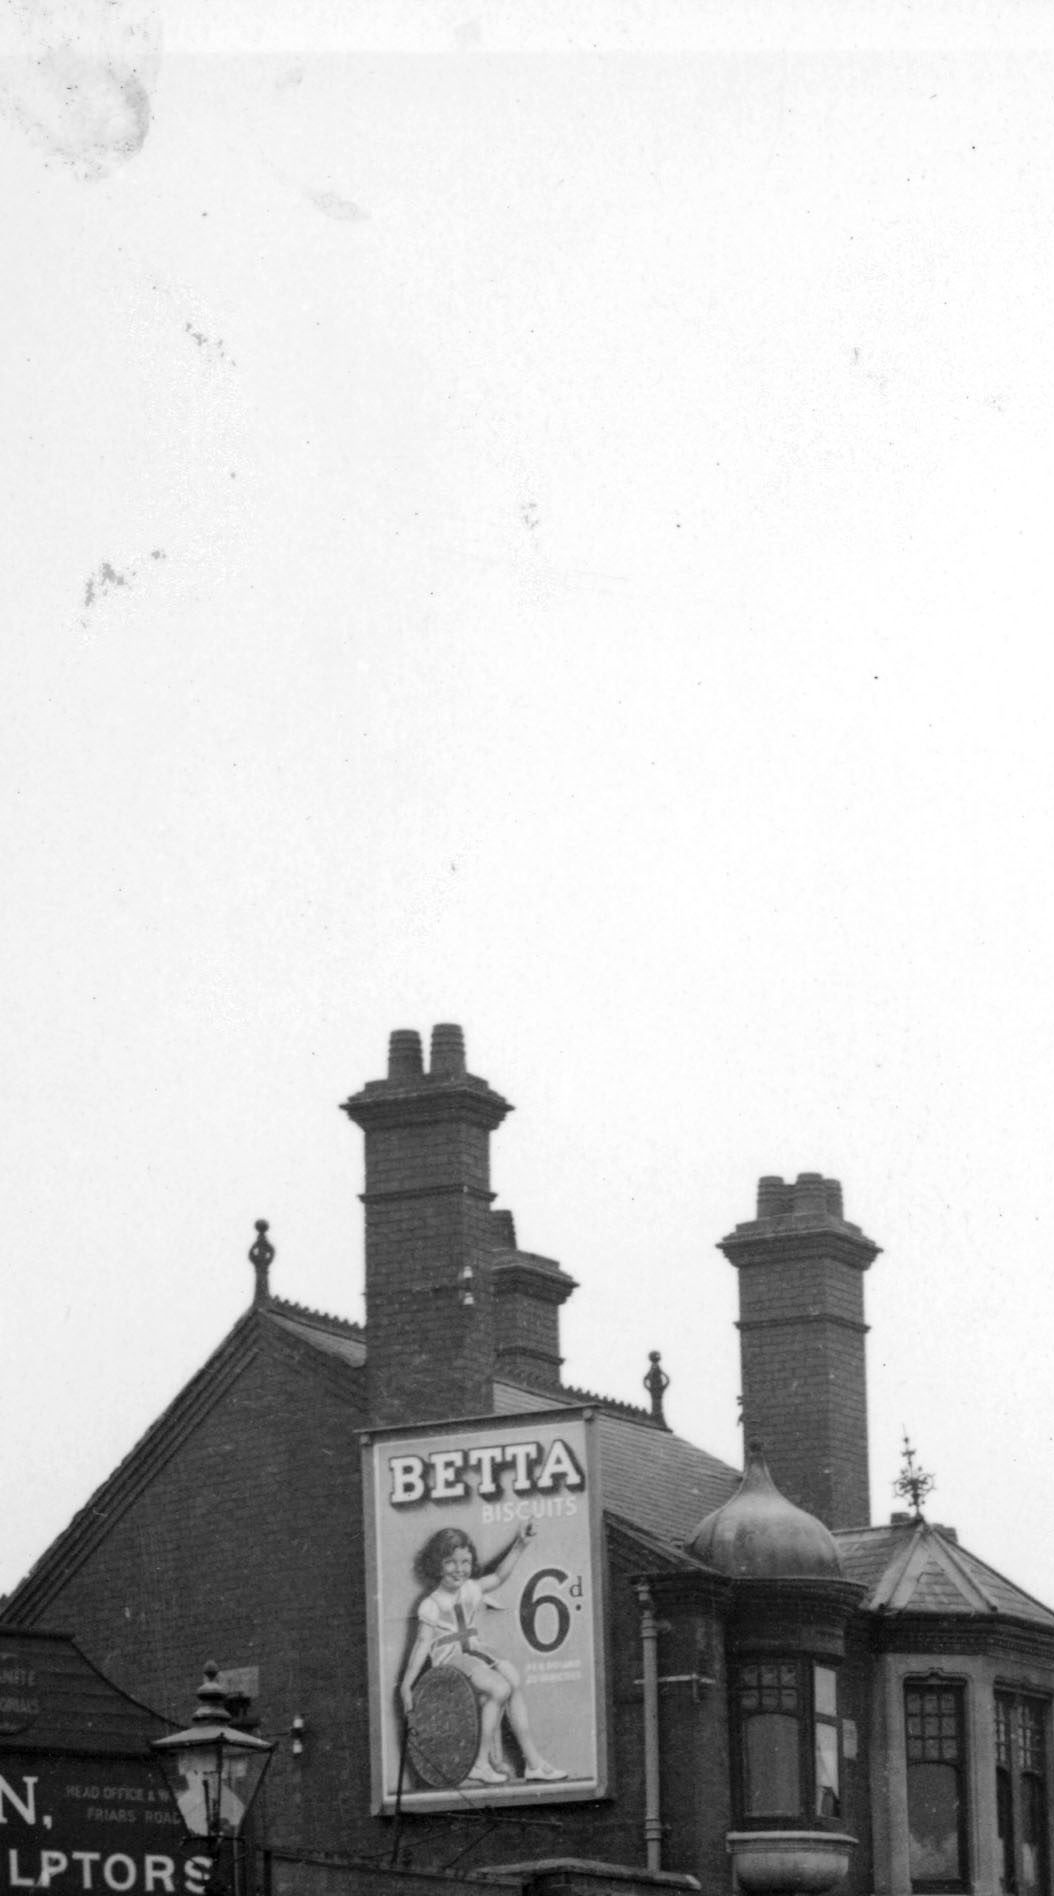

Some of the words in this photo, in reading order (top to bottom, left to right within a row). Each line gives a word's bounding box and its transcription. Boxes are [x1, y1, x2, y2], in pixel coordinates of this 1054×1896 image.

[390, 1439, 586, 1506] BETTA
[480, 1495, 578, 1525] BISCUITS
[66, 1784, 100, 1800] HEAD
[103, 1787, 144, 1802] OFFICE
[87, 1807, 137, 1823] FRIARS
[8, 1848, 214, 1896] LPTORS
